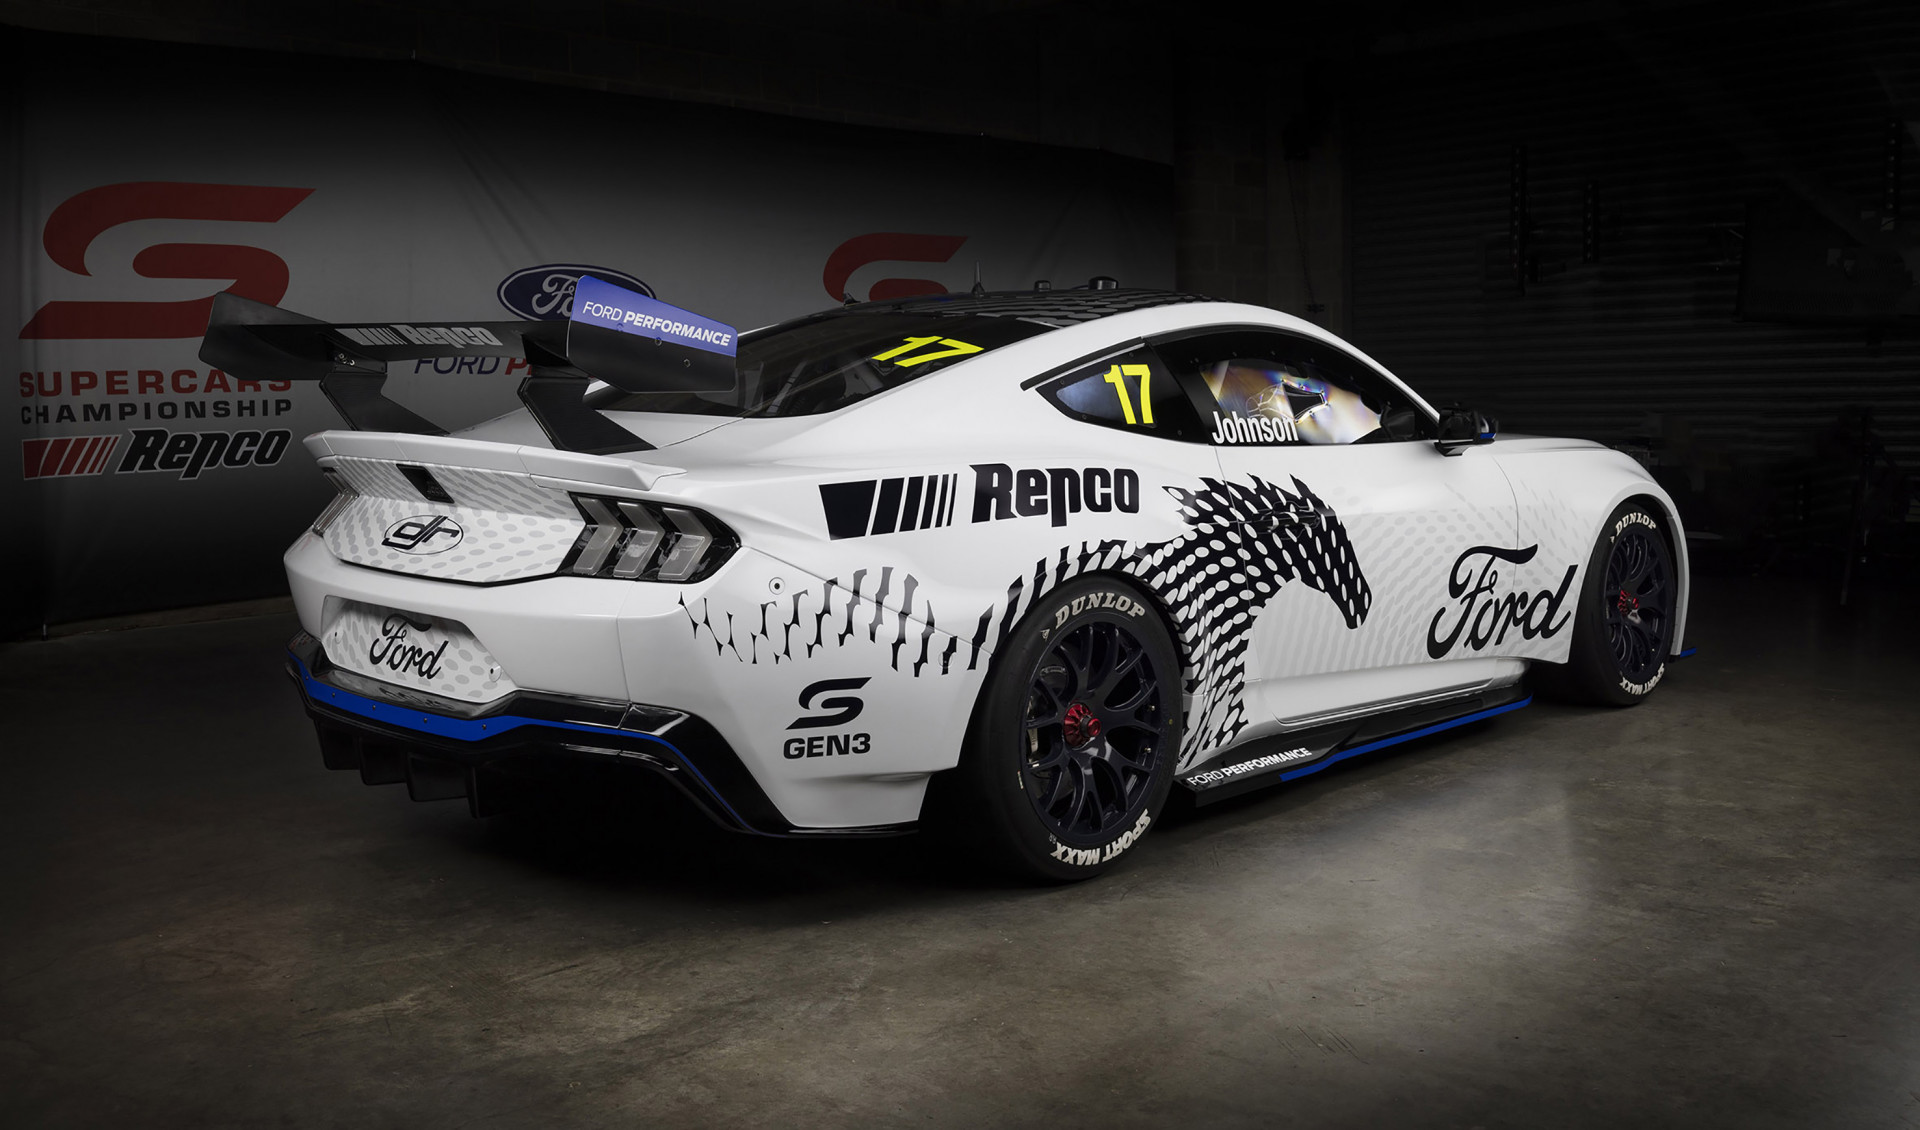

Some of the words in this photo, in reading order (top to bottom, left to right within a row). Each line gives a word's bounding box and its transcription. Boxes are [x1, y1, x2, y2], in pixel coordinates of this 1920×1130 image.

[582, 301, 623, 321] FORD
[623, 311, 732, 347] PERFORMANCE
[872, 336, 985, 367] 17
[21, 399, 292, 425] CHAMPIONSHIP
[1103, 364, 1154, 424] 17
[1211, 411, 1299, 445] Johnson
[115, 428, 292, 480] Repco
[969, 463, 1140, 528] Repco
[1615, 512, 1657, 537] DUNLOP
[1055, 592, 1146, 629] DUNLOP
[1427, 543, 1579, 660] Ford
[368, 613, 449, 679] Ford
[1619, 676, 1643, 695] MAXX
[1643, 662, 1665, 694] SPORT
[783, 733, 871, 760] GEN3
[1186, 770, 1224, 786] FORD
[1220, 747, 1312, 777] PERFORMANCE
[1102, 808, 1151, 862] SPORT
[1050, 842, 1100, 866] MAXX
